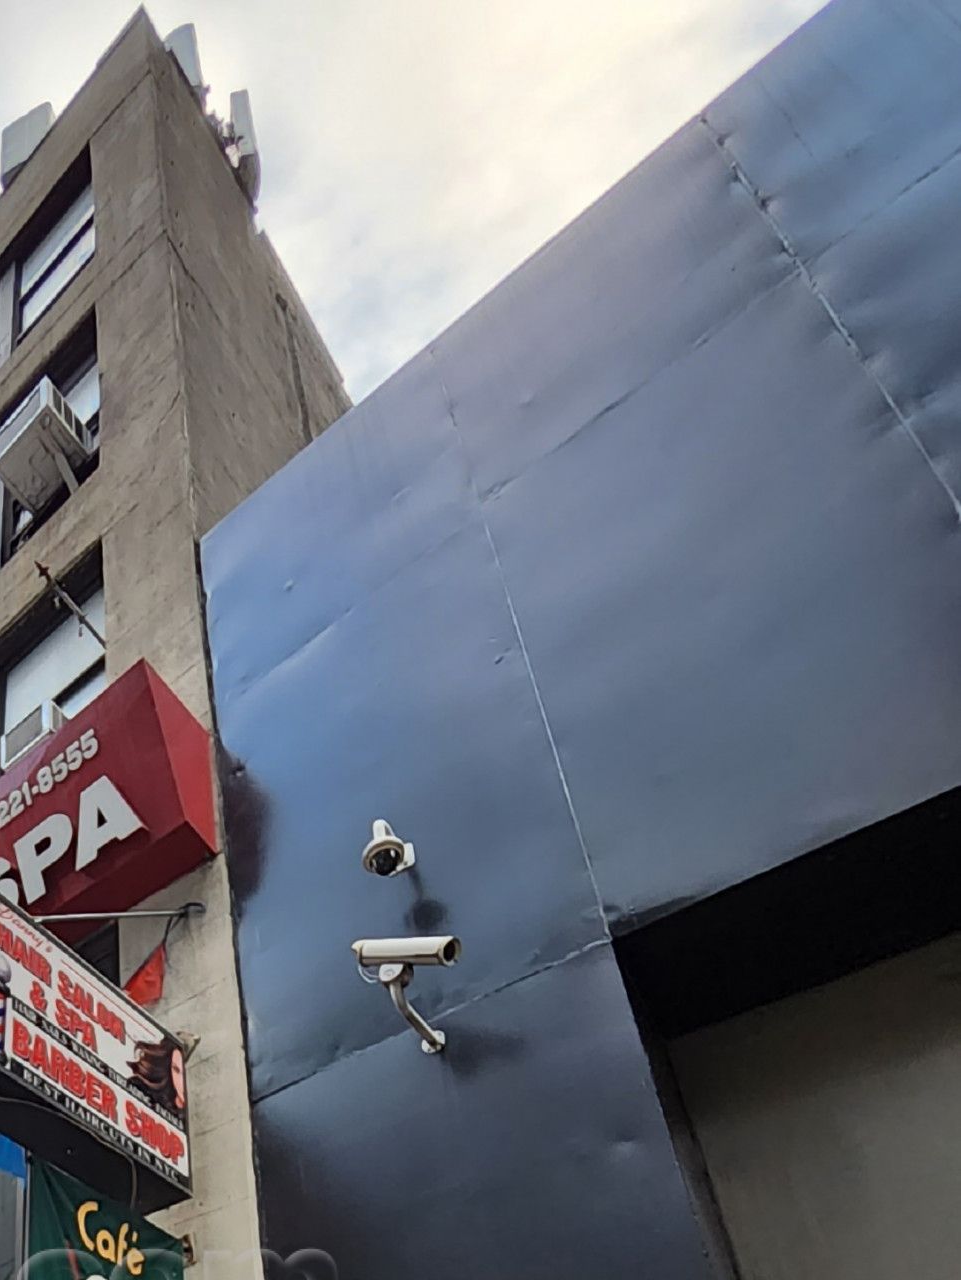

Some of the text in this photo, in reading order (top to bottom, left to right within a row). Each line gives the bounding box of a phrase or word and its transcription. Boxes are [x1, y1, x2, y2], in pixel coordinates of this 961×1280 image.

[29, 981, 98, 1053] & SPA
[57, 970, 126, 1045] SALON
[12, 1018, 185, 1166] BARBER SHOP
[23, 1069, 179, 1181] BEST HAIRCUTS IN NYC
[77, 1201, 147, 1275] Café
